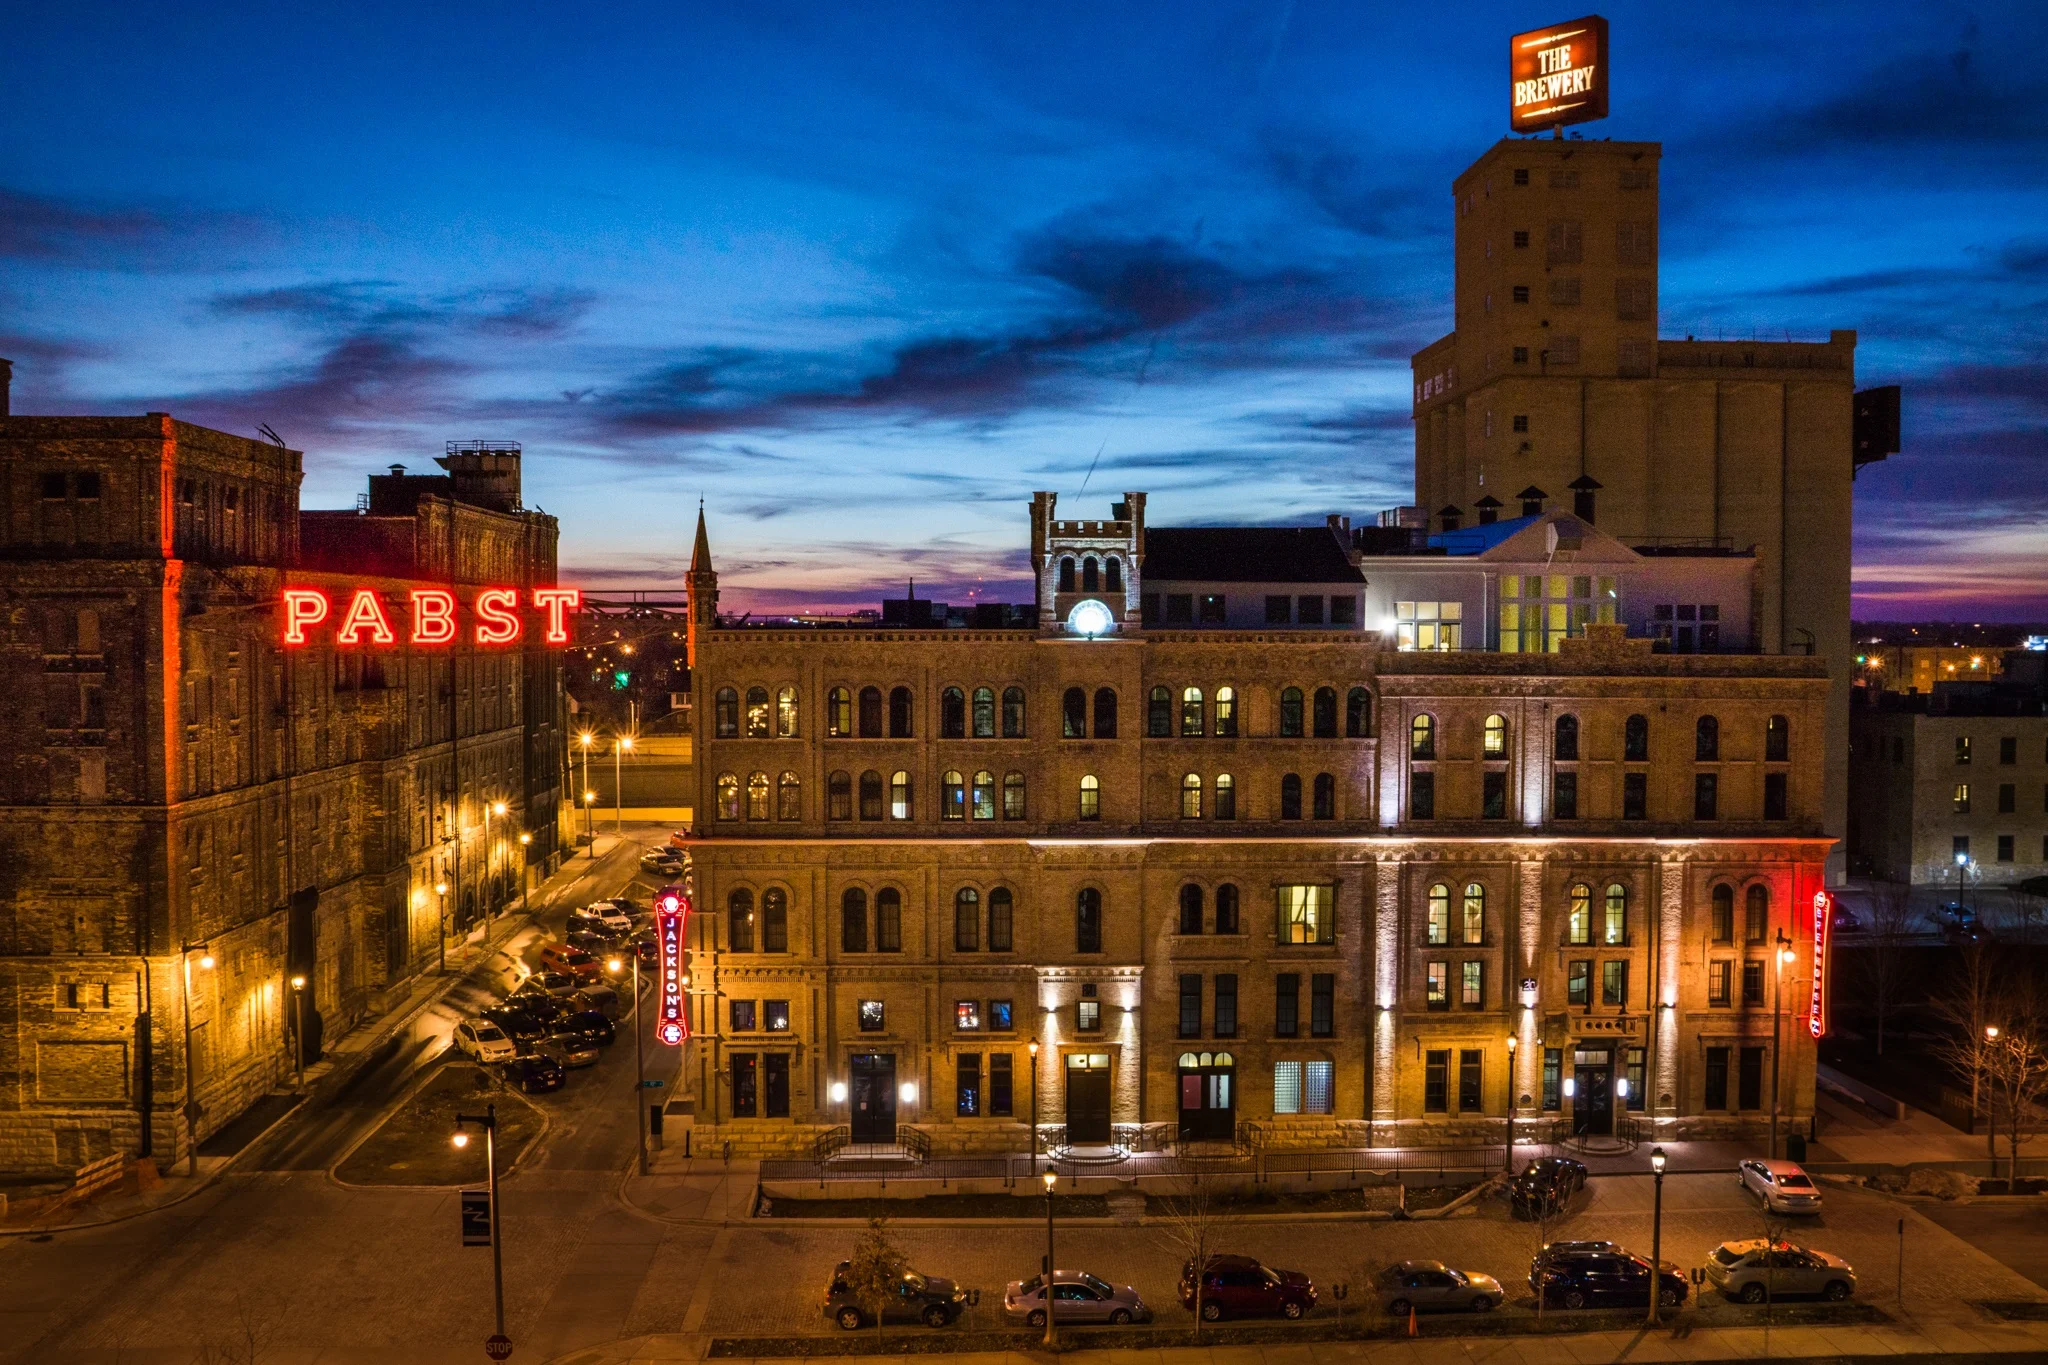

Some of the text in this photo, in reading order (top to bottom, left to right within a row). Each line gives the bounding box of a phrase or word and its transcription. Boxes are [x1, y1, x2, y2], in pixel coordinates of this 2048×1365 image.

[1538, 45, 1572, 75] THE
[1515, 66, 1595, 106] BREWERY
[284, 589, 579, 643] PABST
[666, 918, 681, 1018] JACKSON'S
[487, 1342, 512, 1354] STOP
